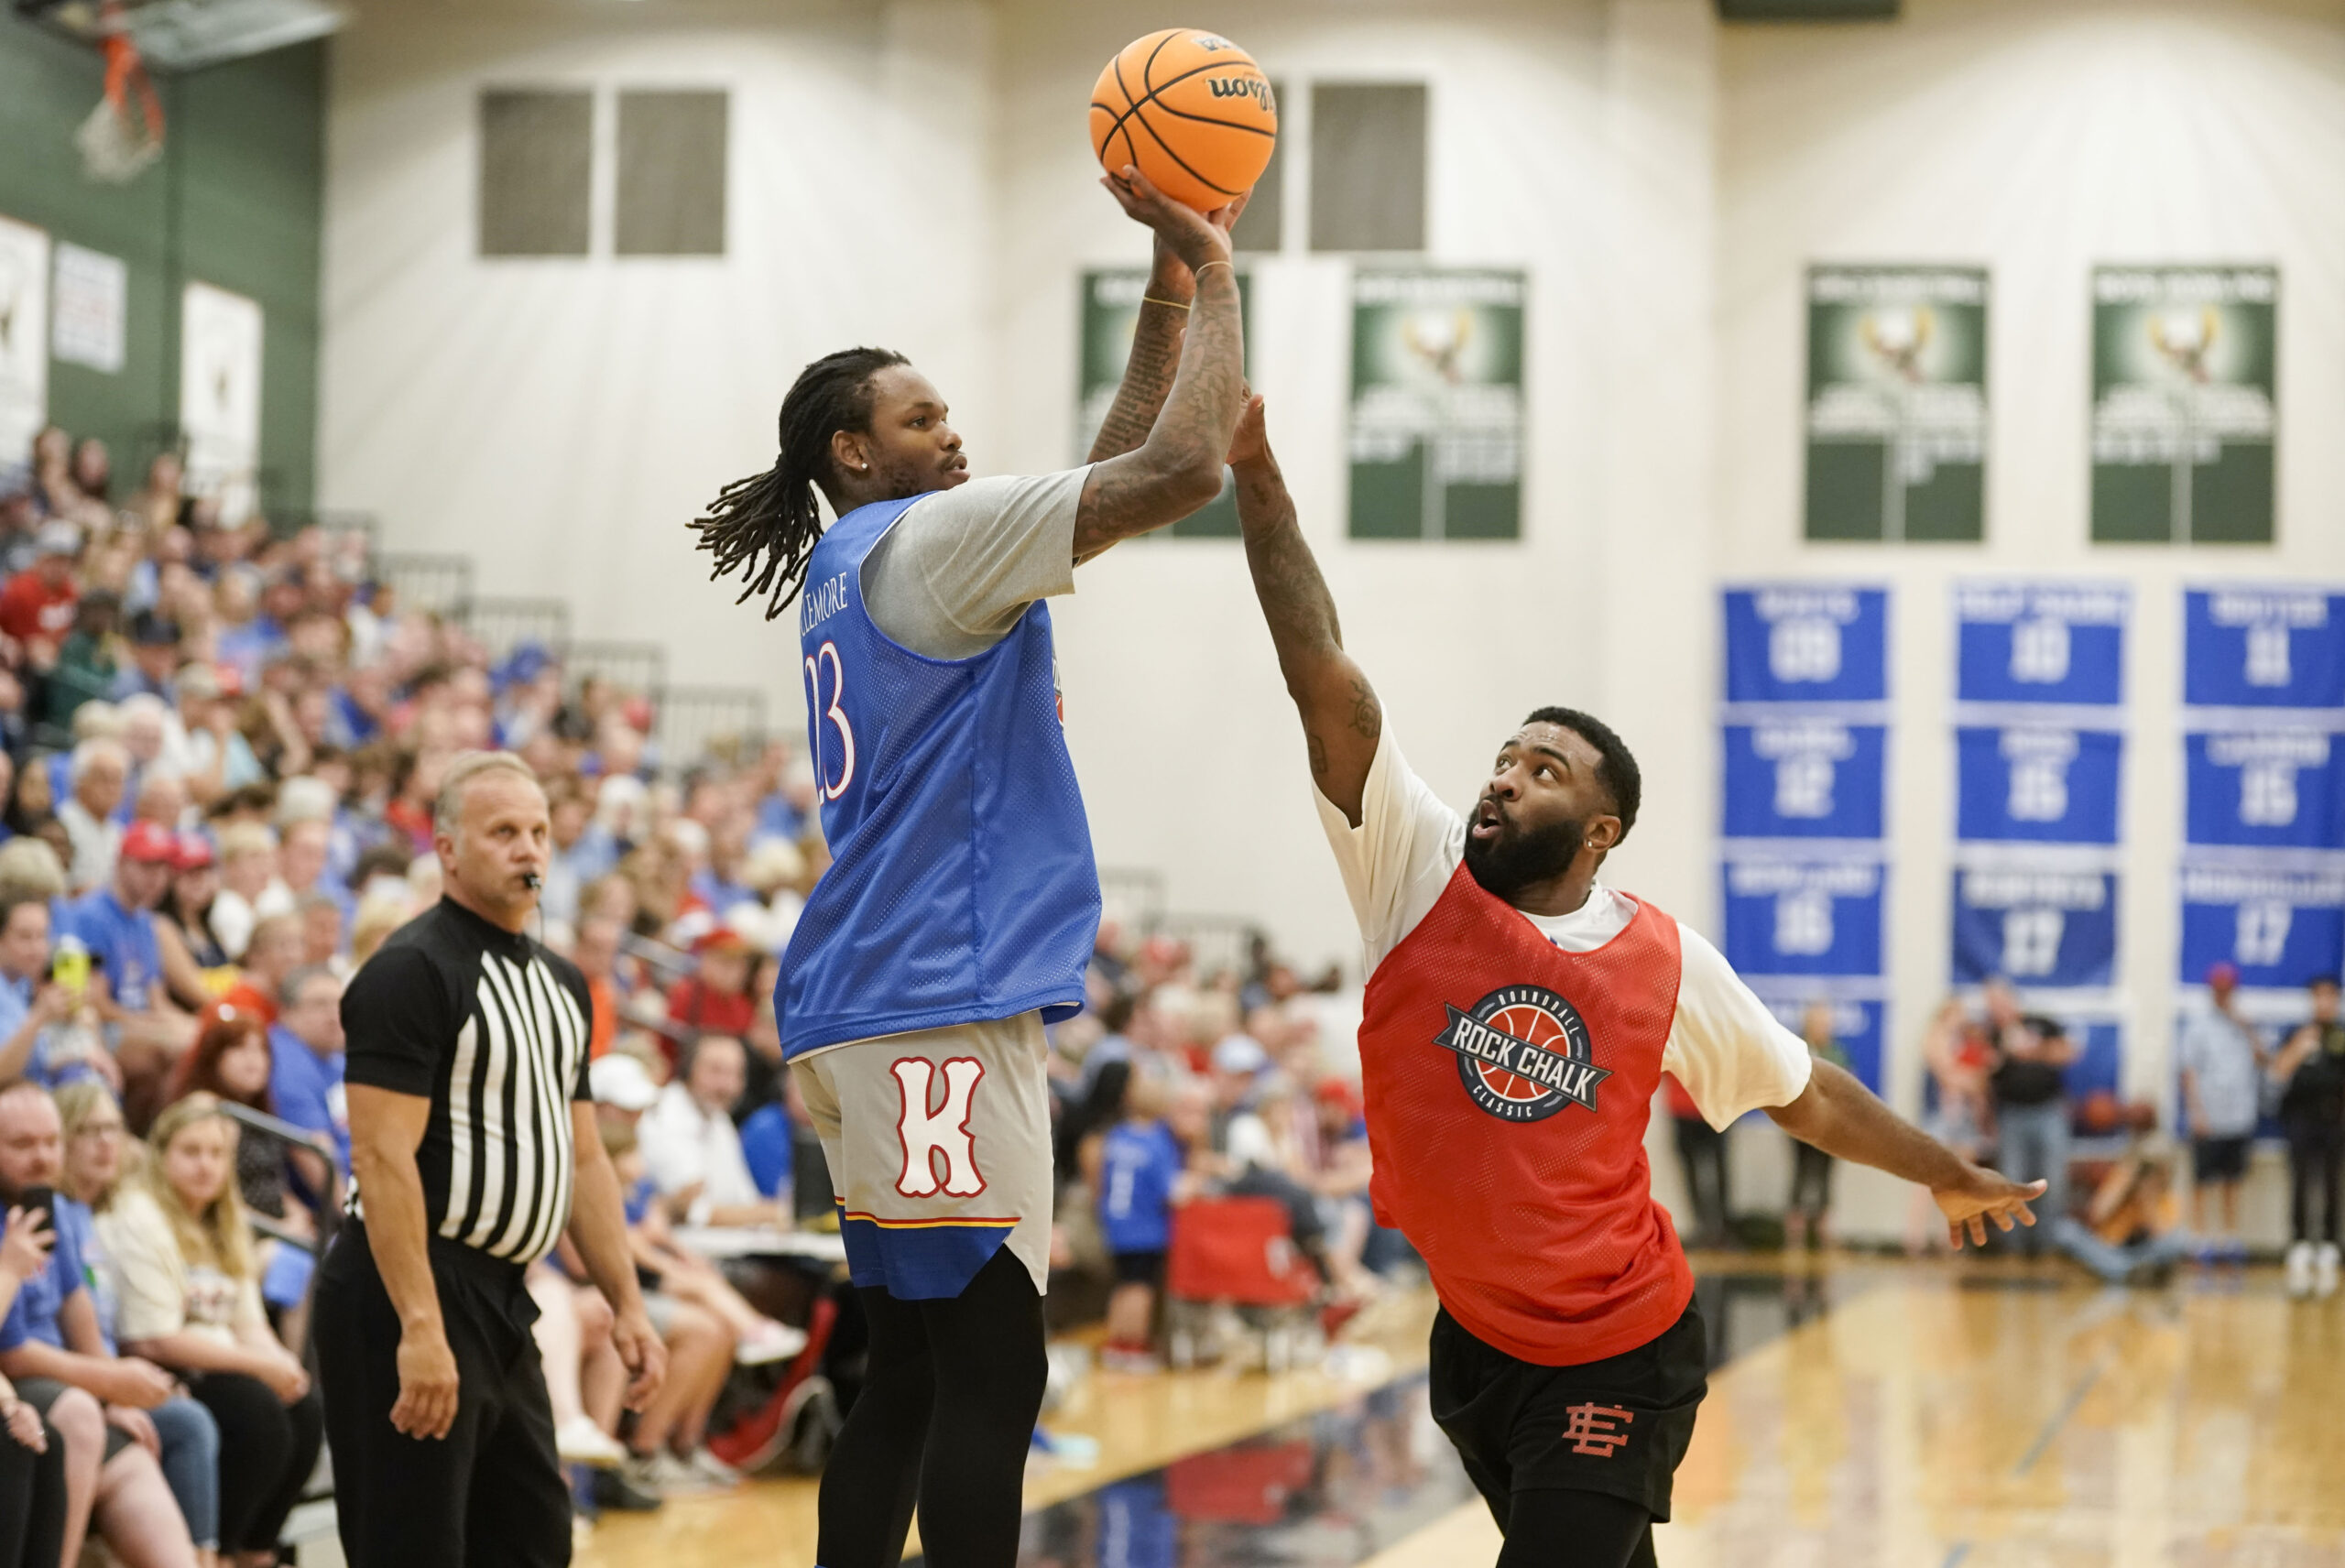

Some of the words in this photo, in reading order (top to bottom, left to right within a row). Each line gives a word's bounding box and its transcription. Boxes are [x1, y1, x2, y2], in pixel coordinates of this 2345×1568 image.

[1206, 77, 1273, 112] lson
[1498, 990, 1580, 1034] ROUNDBALL
[1451, 1016, 1517, 1067] ROCK
[1516, 1046, 1598, 1102] CHALK
[1473, 1084, 1532, 1118] CLASSIC
[889, 1056, 987, 1198] K
